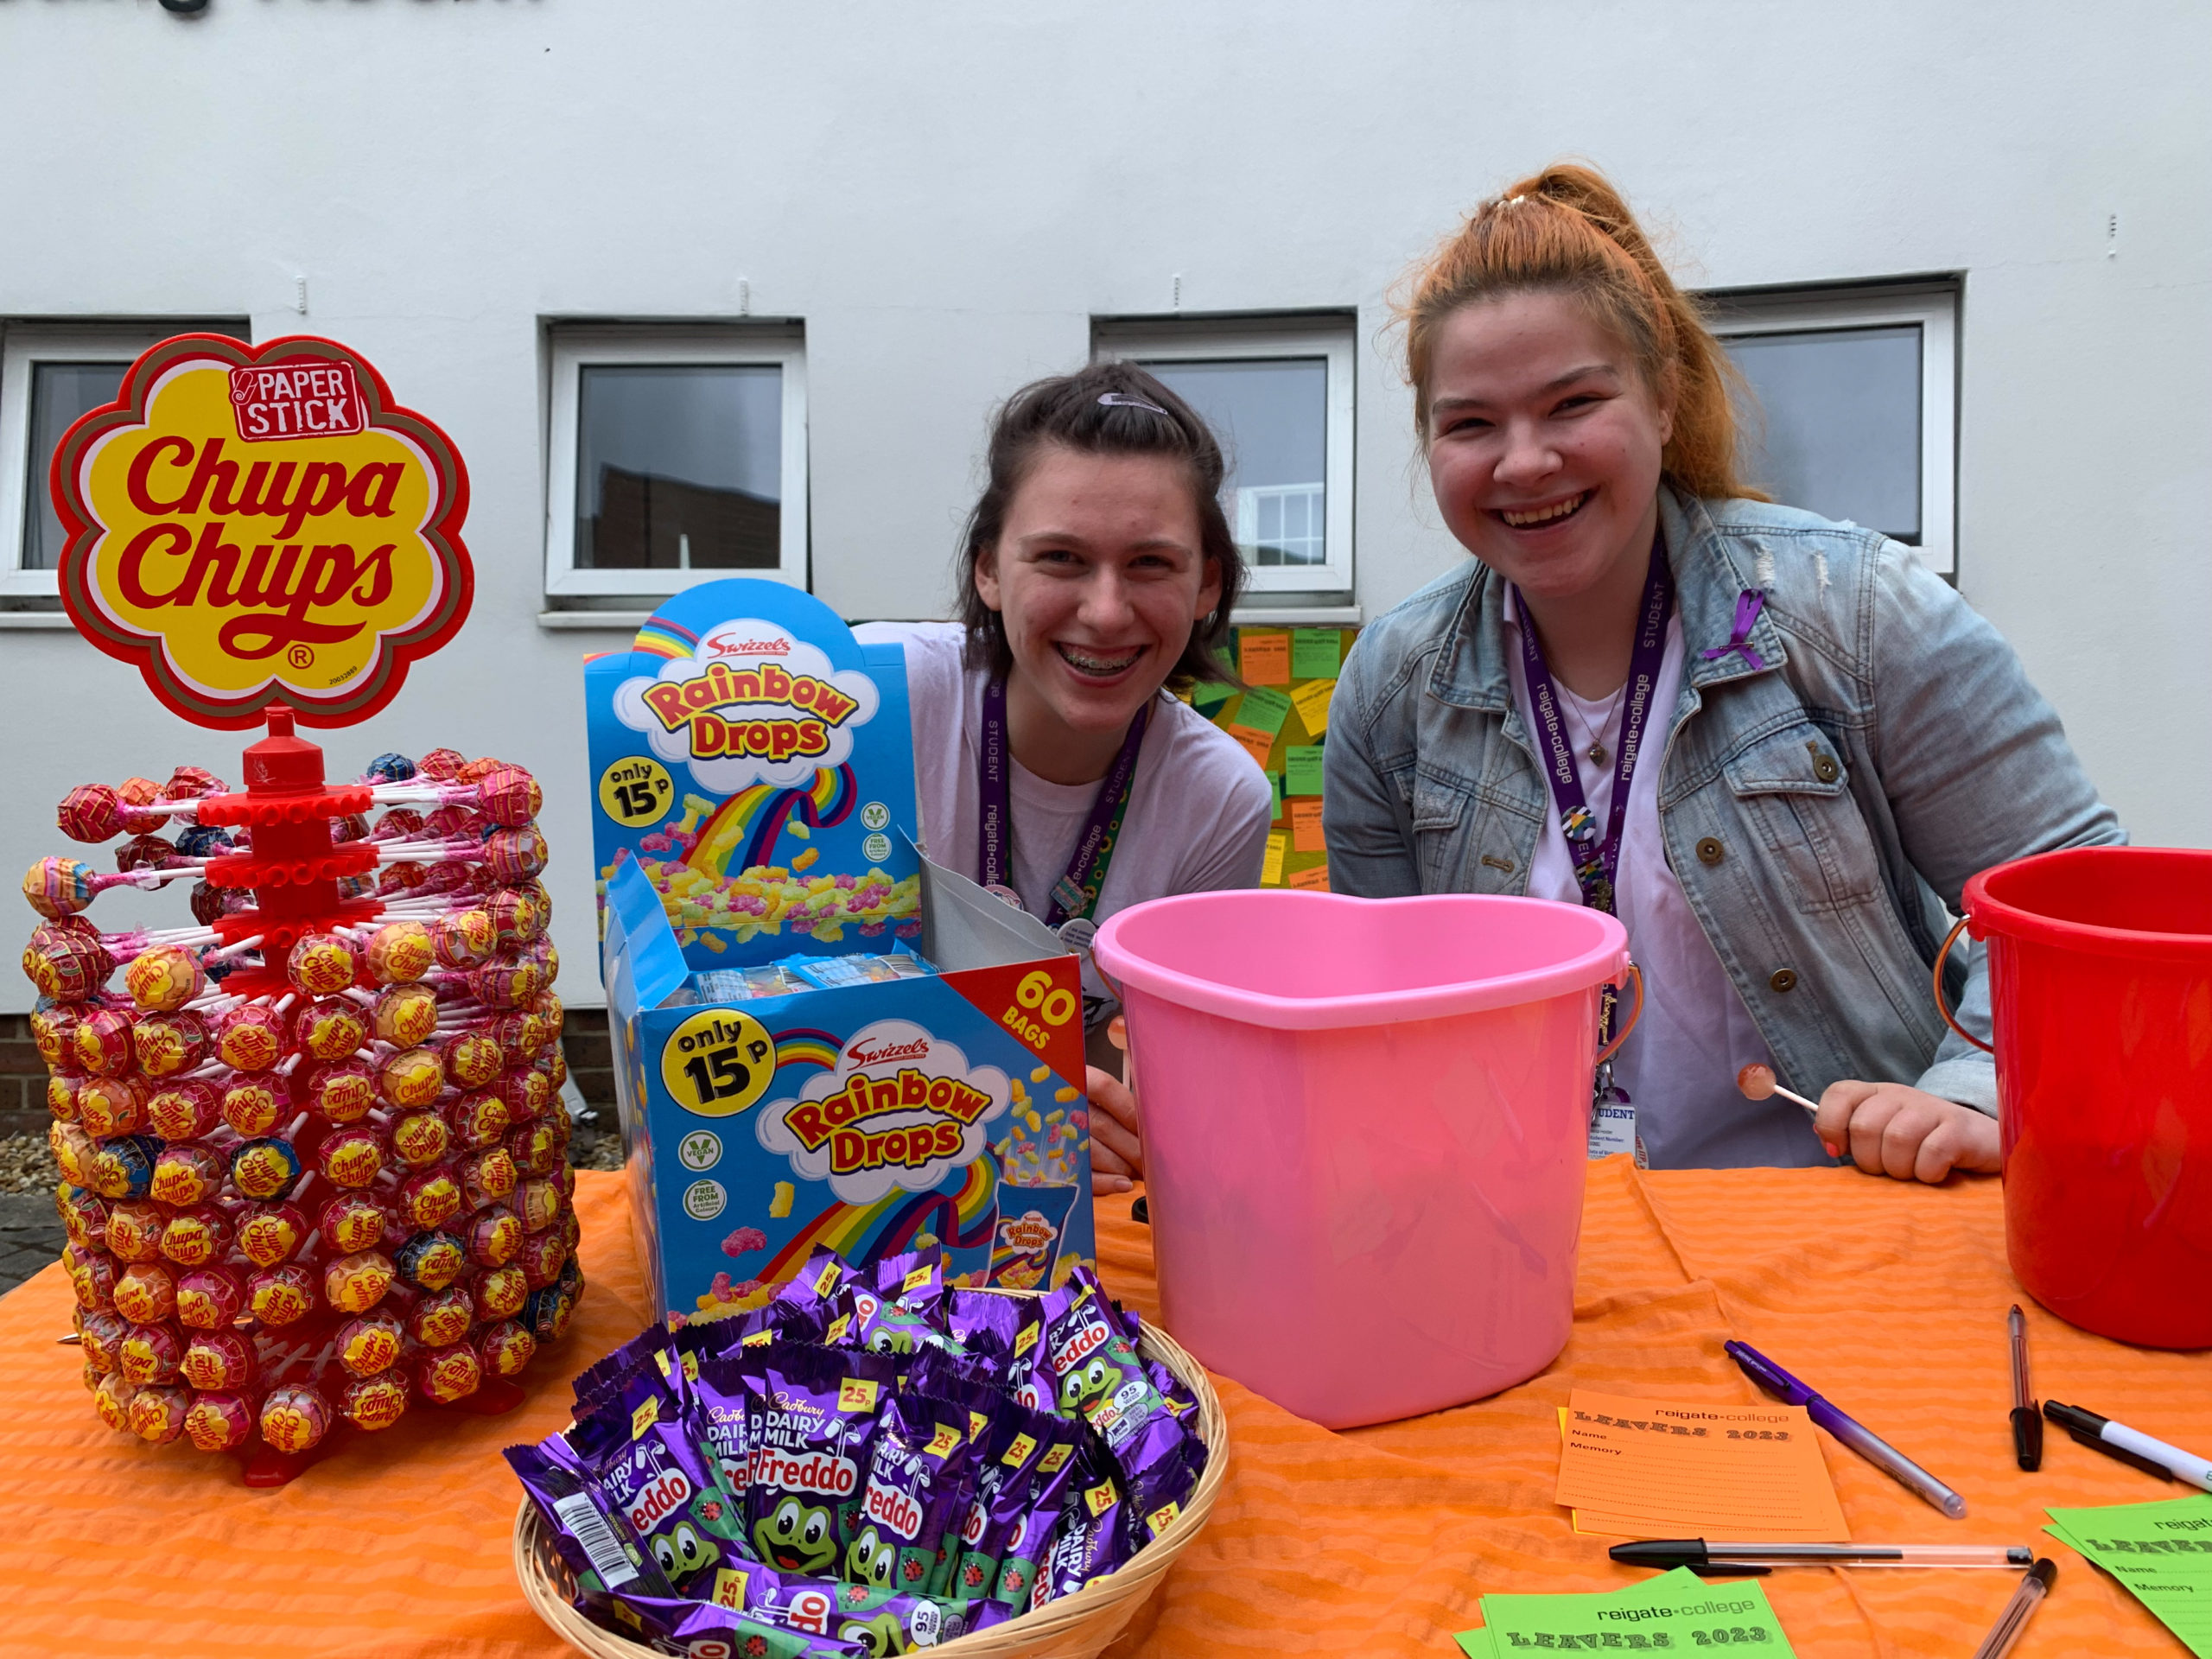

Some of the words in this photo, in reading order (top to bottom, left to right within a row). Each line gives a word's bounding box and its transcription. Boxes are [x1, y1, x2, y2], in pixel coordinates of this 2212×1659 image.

[257, 369, 346, 401] PAPER
[248, 398, 351, 434] STICK
[127, 435, 405, 540] Chupa
[118, 522, 397, 660] Chups
[1643, 582, 1665, 649] STUDENT
[707, 632, 791, 659] Swizzels
[642, 663, 860, 733] Rainbow
[690, 712, 830, 763] Drops
[988, 720, 999, 783] STUDENT
[610, 763, 652, 784] only
[303, 957, 341, 990] Chups
[1014, 971, 1077, 1027] 60
[399, 999, 429, 1035] Chupa
[1001, 1006, 1051, 1050] BAGS
[317, 1018, 346, 1057] Chupa
[678, 1019, 743, 1053] only
[847, 1037, 930, 1071] Swizzels
[400, 1069, 437, 1099] Chupa
[245, 1096, 270, 1132] Chupa
[783, 1069, 994, 1152] Rainbow
[1599, 1108, 1635, 1120] UDENT
[401, 1116, 431, 1148] Chupa
[409, 1125, 443, 1160] Chups
[829, 1118, 964, 1175] Drops
[251, 1152, 284, 1183] Chupa
[333, 1147, 373, 1175] Chupa
[687, 1147, 715, 1158] VEGAN
[153, 1169, 189, 1192] Chupa
[338, 1160, 377, 1185] Chups
[420, 1189, 457, 1210] Chupa
[692, 1192, 719, 1203] FROM
[694, 1185, 716, 1196] FREE
[164, 1229, 204, 1246] Chupa
[345, 1214, 364, 1250] Chupa
[1006, 1222, 1053, 1242] Rainbow
[1013, 1234, 1045, 1249] Drops
[166, 1241, 205, 1263] Chups
[424, 1249, 462, 1270] Chups
[493, 1271, 513, 1307] Chupa
[819, 1268, 836, 1294] 25p
[906, 1274, 928, 1287] 25p
[352, 1332, 378, 1370] Chupa
[364, 1338, 394, 1374] Chups
[1054, 1326, 1106, 1373] eddo
[435, 1373, 473, 1394] Chupa
[682, 1361, 696, 1376] 5p
[360, 1389, 402, 1413] Chups
[768, 1391, 825, 1421] Cadbury
[843, 1386, 871, 1407] 25p
[1121, 1384, 1137, 1399] 95
[358, 1408, 400, 1422] Chupa
[766, 1410, 827, 1433] DAIRY
[1573, 1410, 1709, 1437] LEAVERS
[1726, 1429, 1791, 1441] 2023
[707, 1423, 748, 1442] DAIR
[764, 1428, 810, 1450] MILK
[1572, 1429, 1608, 1441] Name
[877, 1441, 911, 1466] AIRY
[1570, 1441, 1623, 1457] Memory
[604, 1456, 632, 1491] AIRY
[759, 1448, 854, 1492] Freddo
[873, 1458, 893, 1482] ILK
[612, 1479, 637, 1505] LK
[632, 1476, 687, 1532] eddo
[866, 1484, 918, 1535] reddo
[1054, 1531, 1073, 1574] MILK
[1067, 1522, 1089, 1578] DAIRY
[1081, 1517, 1103, 1573] Cadbury
[2133, 1583, 2195, 1593] Memory
[915, 1611, 929, 1633] 95
[1506, 1630, 1671, 1650] LEAVERS
[1691, 1626, 1768, 1647] 2023
